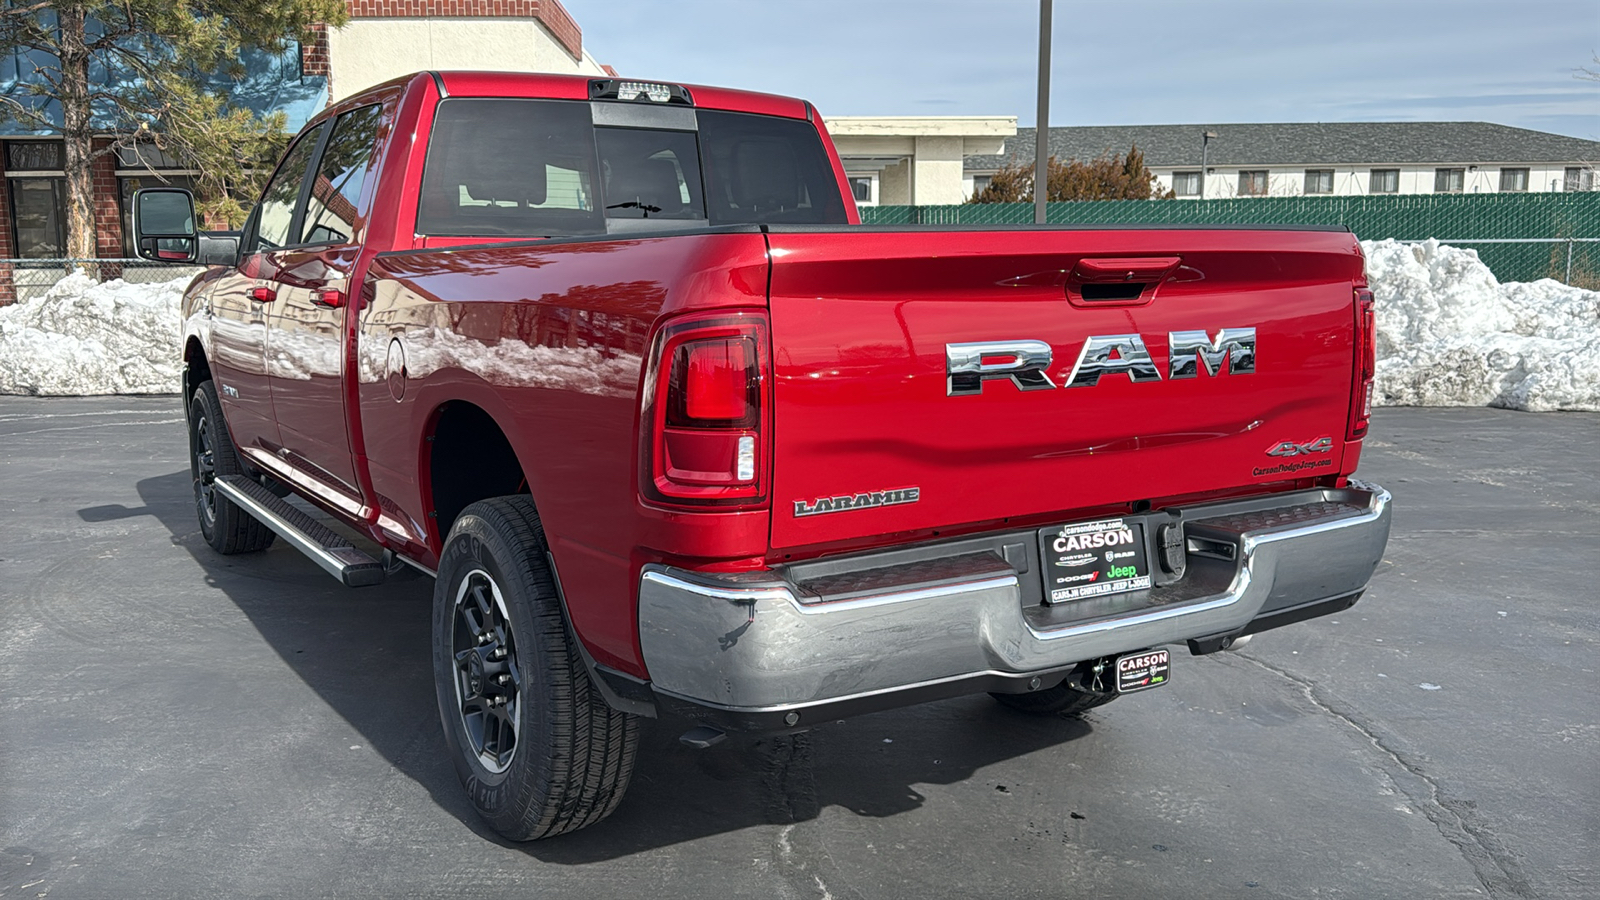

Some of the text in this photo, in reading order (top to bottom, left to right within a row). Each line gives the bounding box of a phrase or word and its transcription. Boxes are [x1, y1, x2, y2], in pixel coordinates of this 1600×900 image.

[946, 327, 1257, 397] RAM
[1253, 459, 1332, 476] CarsonDodgeJeep.com
[793, 487, 920, 517] LARAMIE
[1066, 521, 1121, 535] carsondodge.com
[1053, 529, 1134, 553] CARSON
[1059, 553, 1092, 561] CHRYSLER
[1057, 573, 1094, 583] DODGE
[1107, 564, 1137, 578] Jeep
[1079, 583, 1111, 596] CHRYSLER
[1112, 581, 1127, 591] JEEP
[1120, 653, 1168, 671] CARSON
